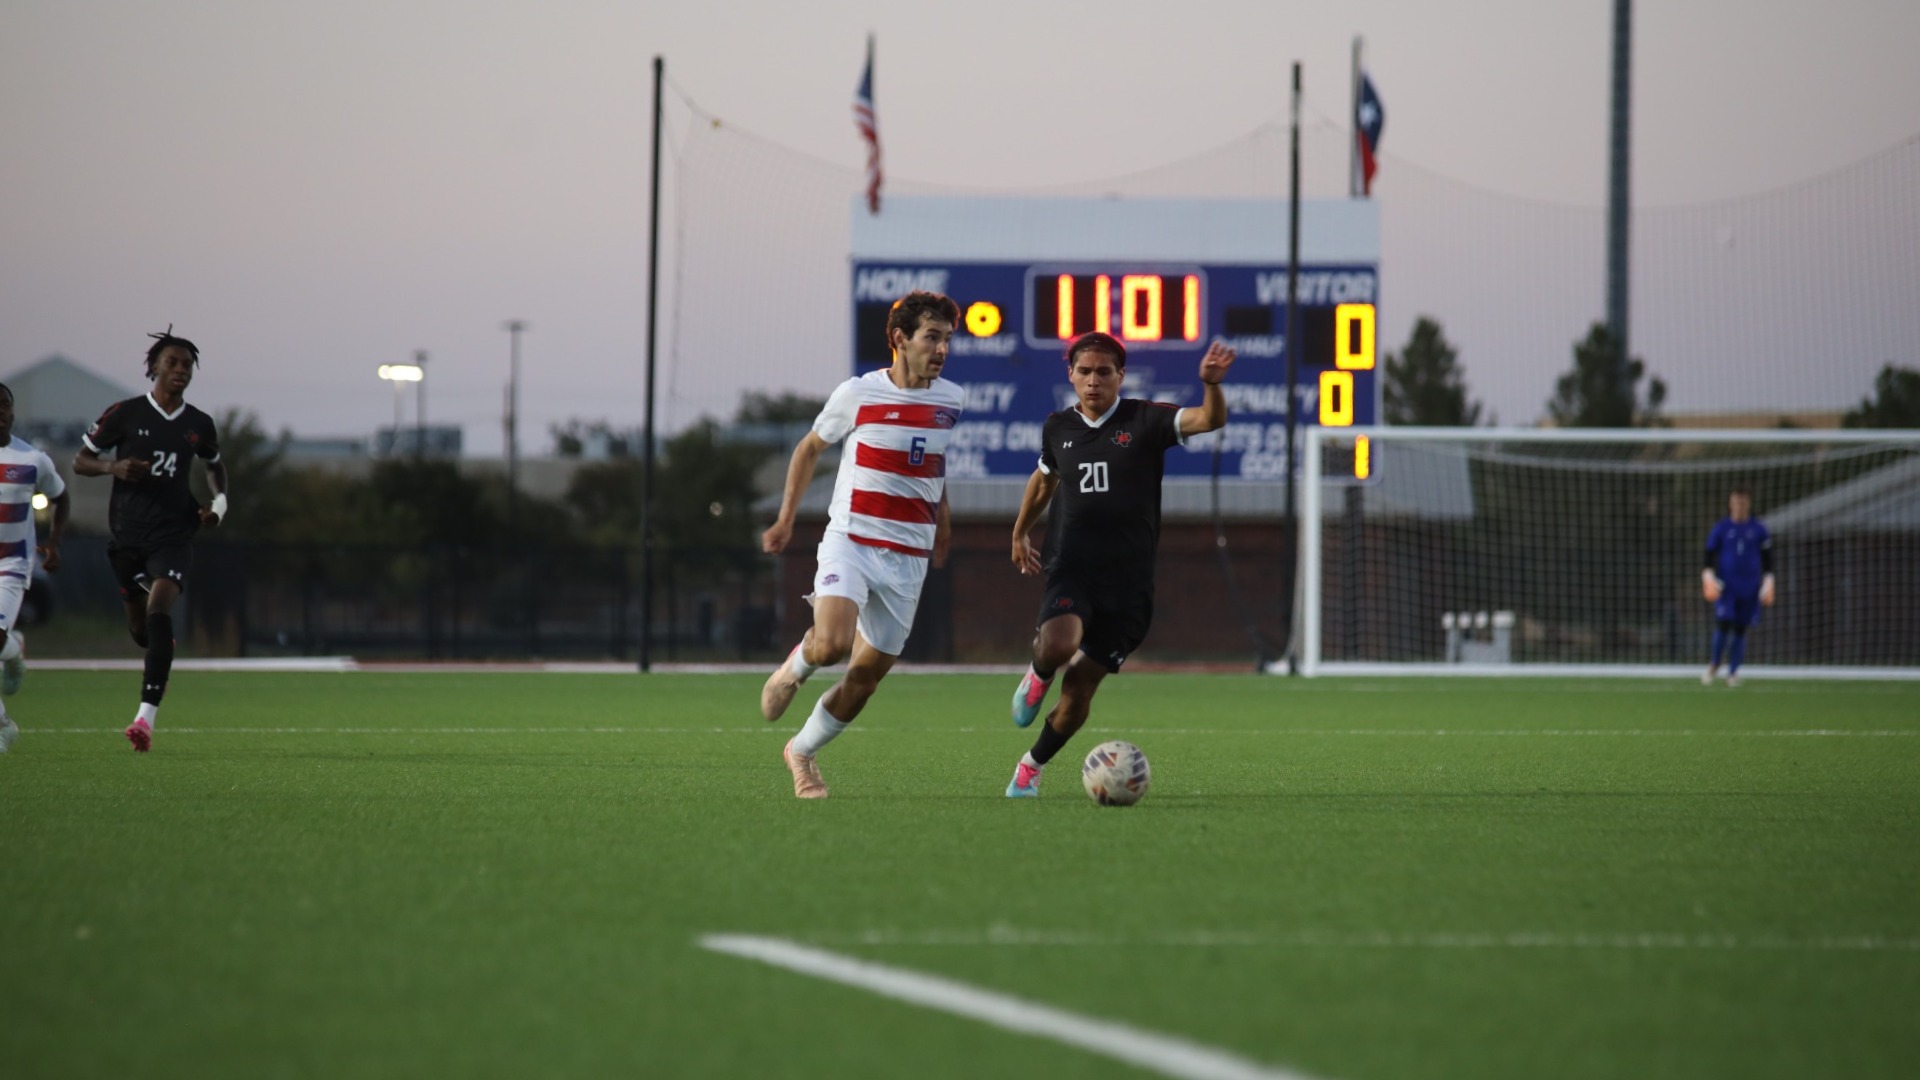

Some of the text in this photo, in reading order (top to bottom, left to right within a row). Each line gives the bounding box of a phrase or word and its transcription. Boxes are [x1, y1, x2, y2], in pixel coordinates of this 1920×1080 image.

[856, 269, 949, 300] HOME
[1335, 303, 1375, 369] 0
[1319, 371, 1354, 427] 0
[151, 450, 177, 477] 24
[908, 436, 926, 465] 6
[1354, 433, 1370, 480] 1
[1078, 461, 1109, 493] 20
